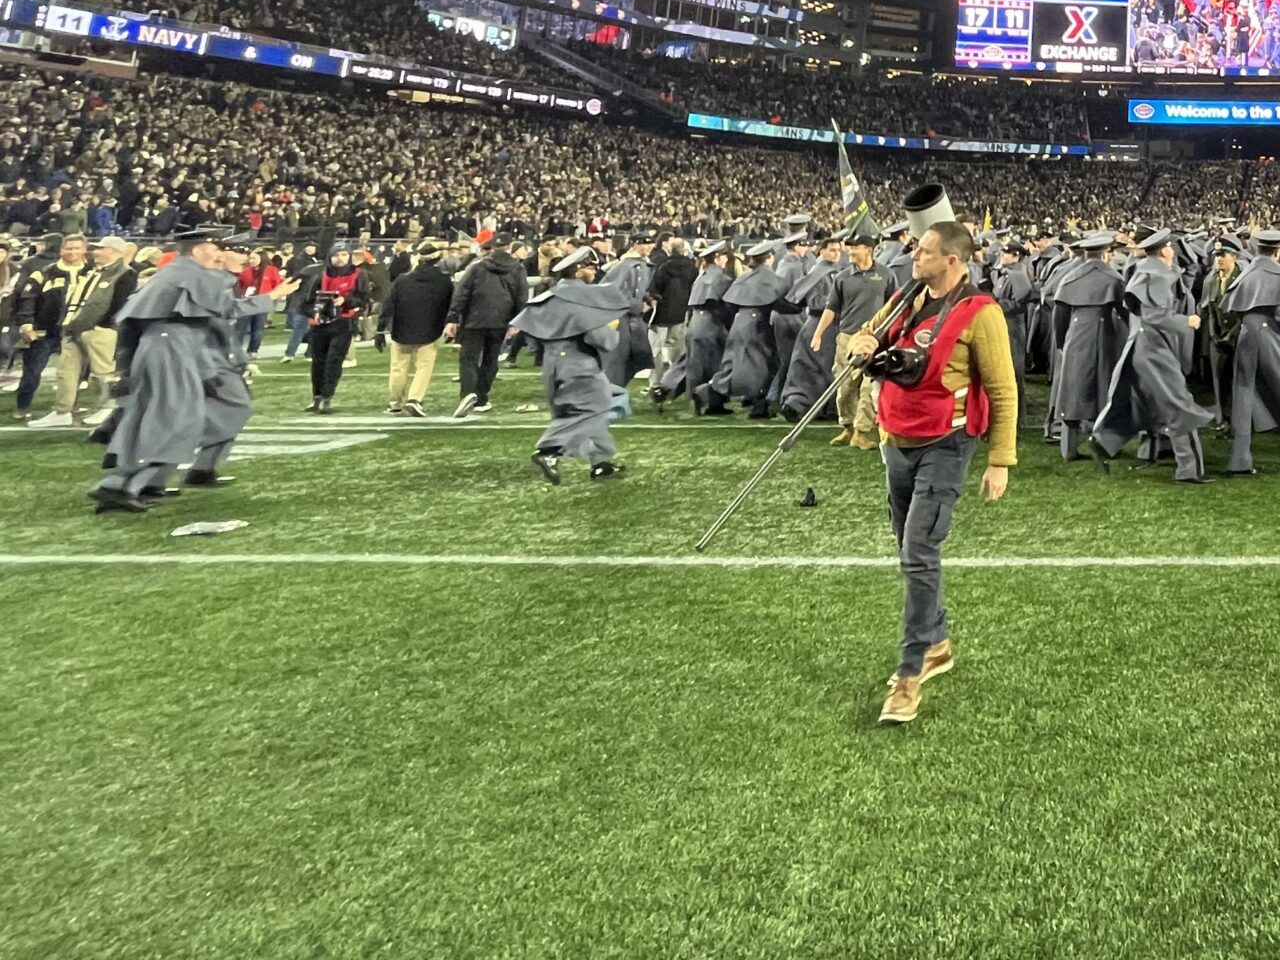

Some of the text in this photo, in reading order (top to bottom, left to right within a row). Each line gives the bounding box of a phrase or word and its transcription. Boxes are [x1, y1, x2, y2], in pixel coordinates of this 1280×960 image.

[57, 13, 83, 31] 11
[965, 7, 989, 27] 17
[1005, 9, 1024, 28] 11
[137, 25, 200, 49] NAVY
[291, 55, 313, 68] ON
[1040, 45, 1118, 62] EXCHANGE
[1165, 104, 1229, 118] Welcome
[1232, 105, 1247, 118] to
[1250, 105, 1272, 119] the
